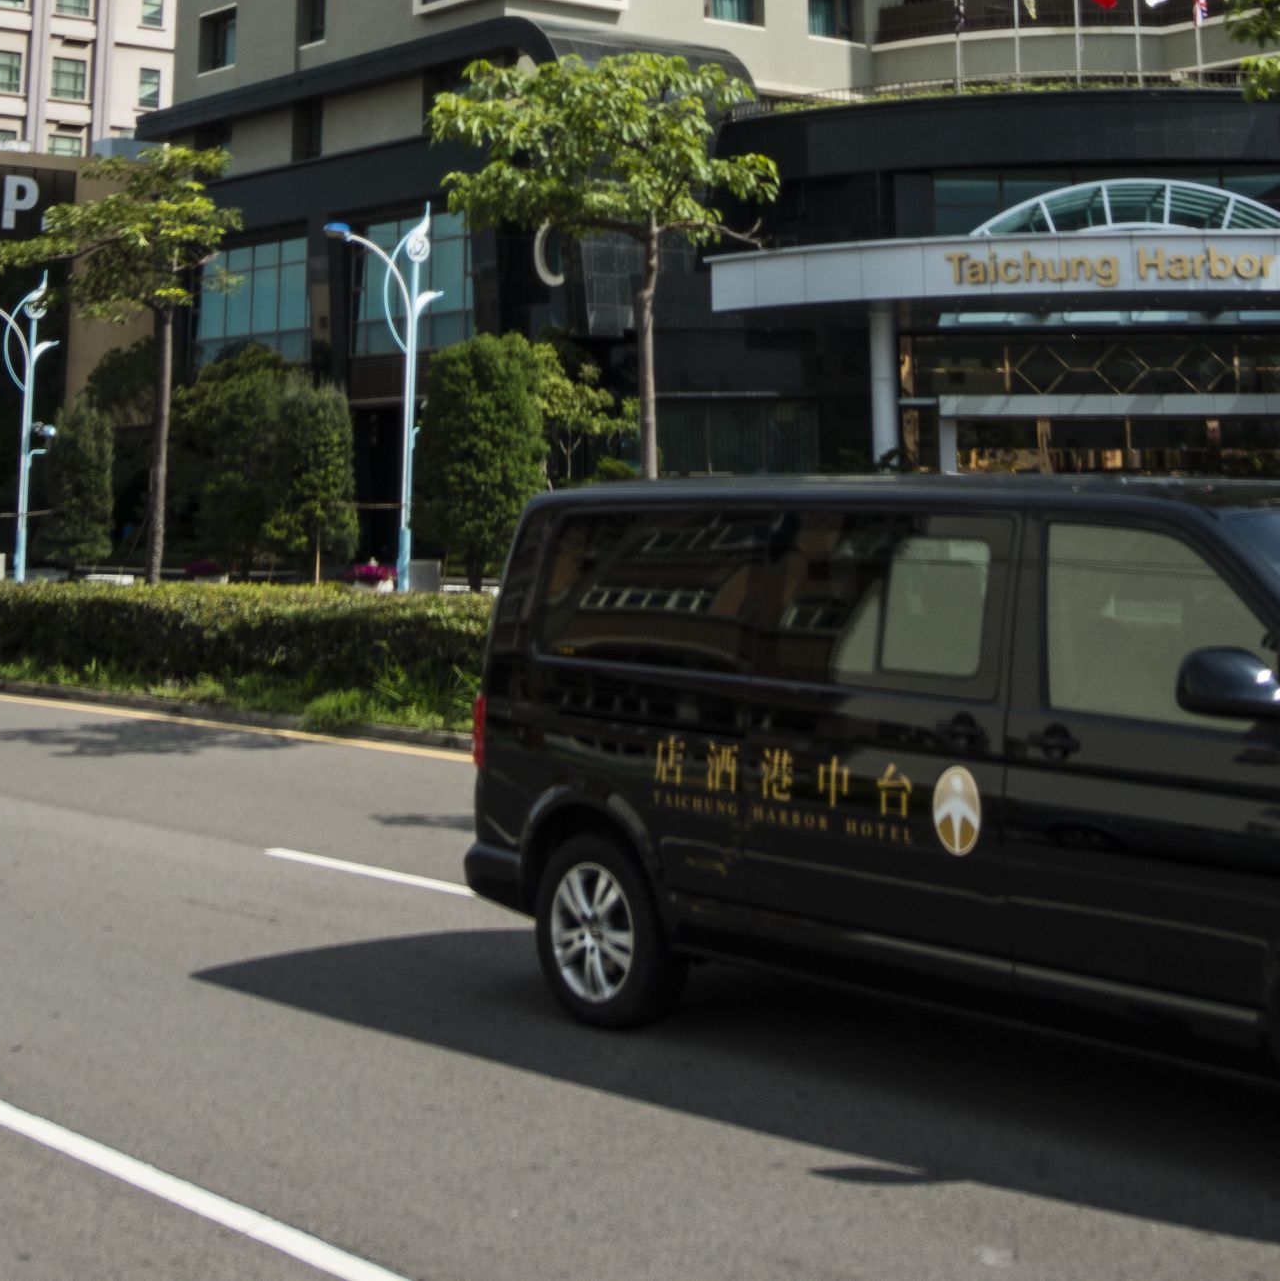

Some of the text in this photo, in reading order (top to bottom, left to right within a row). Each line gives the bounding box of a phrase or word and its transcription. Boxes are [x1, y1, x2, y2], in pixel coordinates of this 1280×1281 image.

[946, 250, 1118, 287] Taichung
[1137, 246, 1275, 280] Harbor
[654, 790, 913, 844] TAICHUNG HARBOR HOTEL
